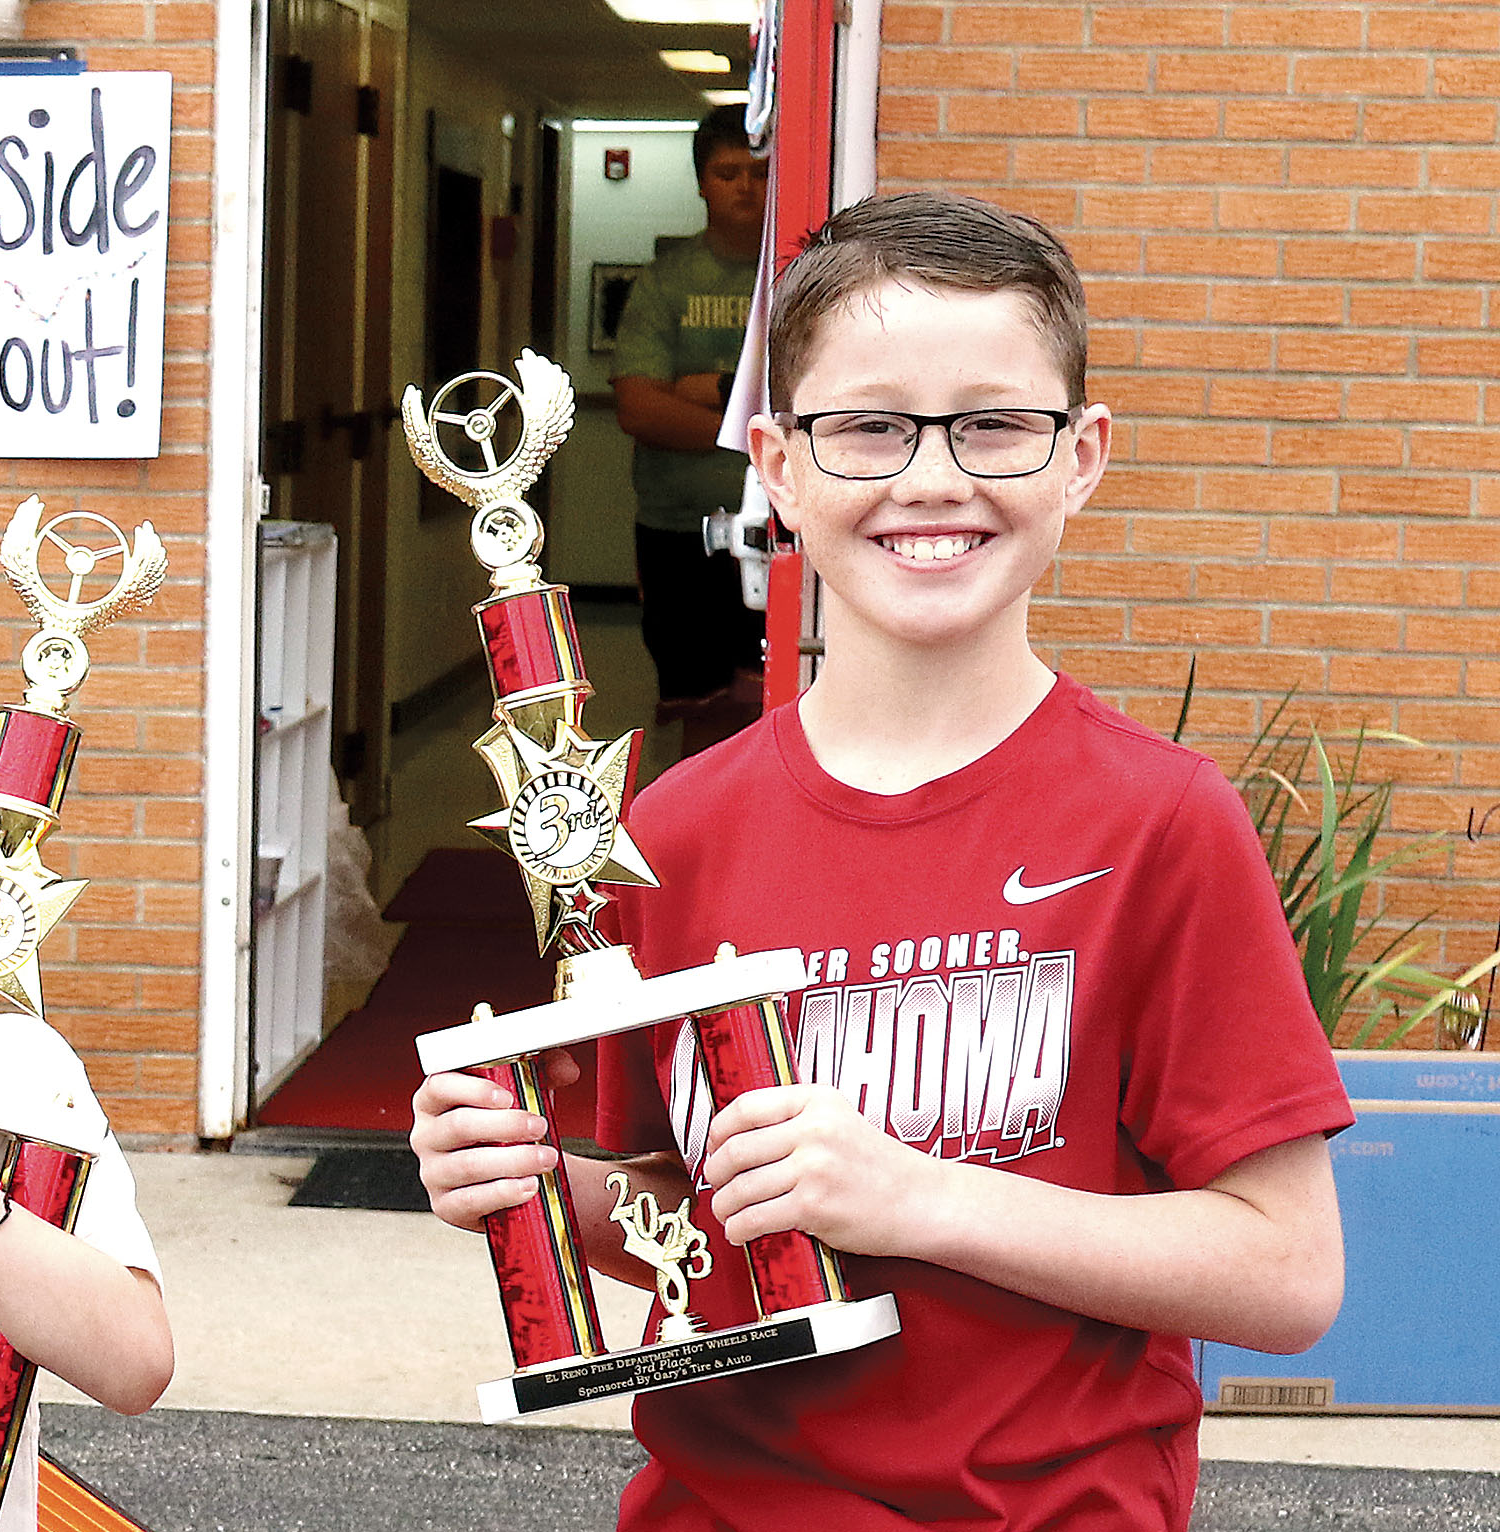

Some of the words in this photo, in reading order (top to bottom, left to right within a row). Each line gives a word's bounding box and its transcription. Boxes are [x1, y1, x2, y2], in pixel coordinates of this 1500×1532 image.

[0, 278, 140, 424] out!
[532, 794, 601, 860] 3rd
[604, 1171, 714, 1280] 2023
[578, 1377, 635, 1397] Sponsored
[637, 1375, 651, 1385] By
[653, 1367, 688, 1382] Gary's
[689, 1362, 712, 1374] Tire
[714, 1359, 724, 1368] &
[726, 1354, 752, 1367] Auto
[634, 1363, 656, 1375] 3rd
[659, 1356, 692, 1370] Place
